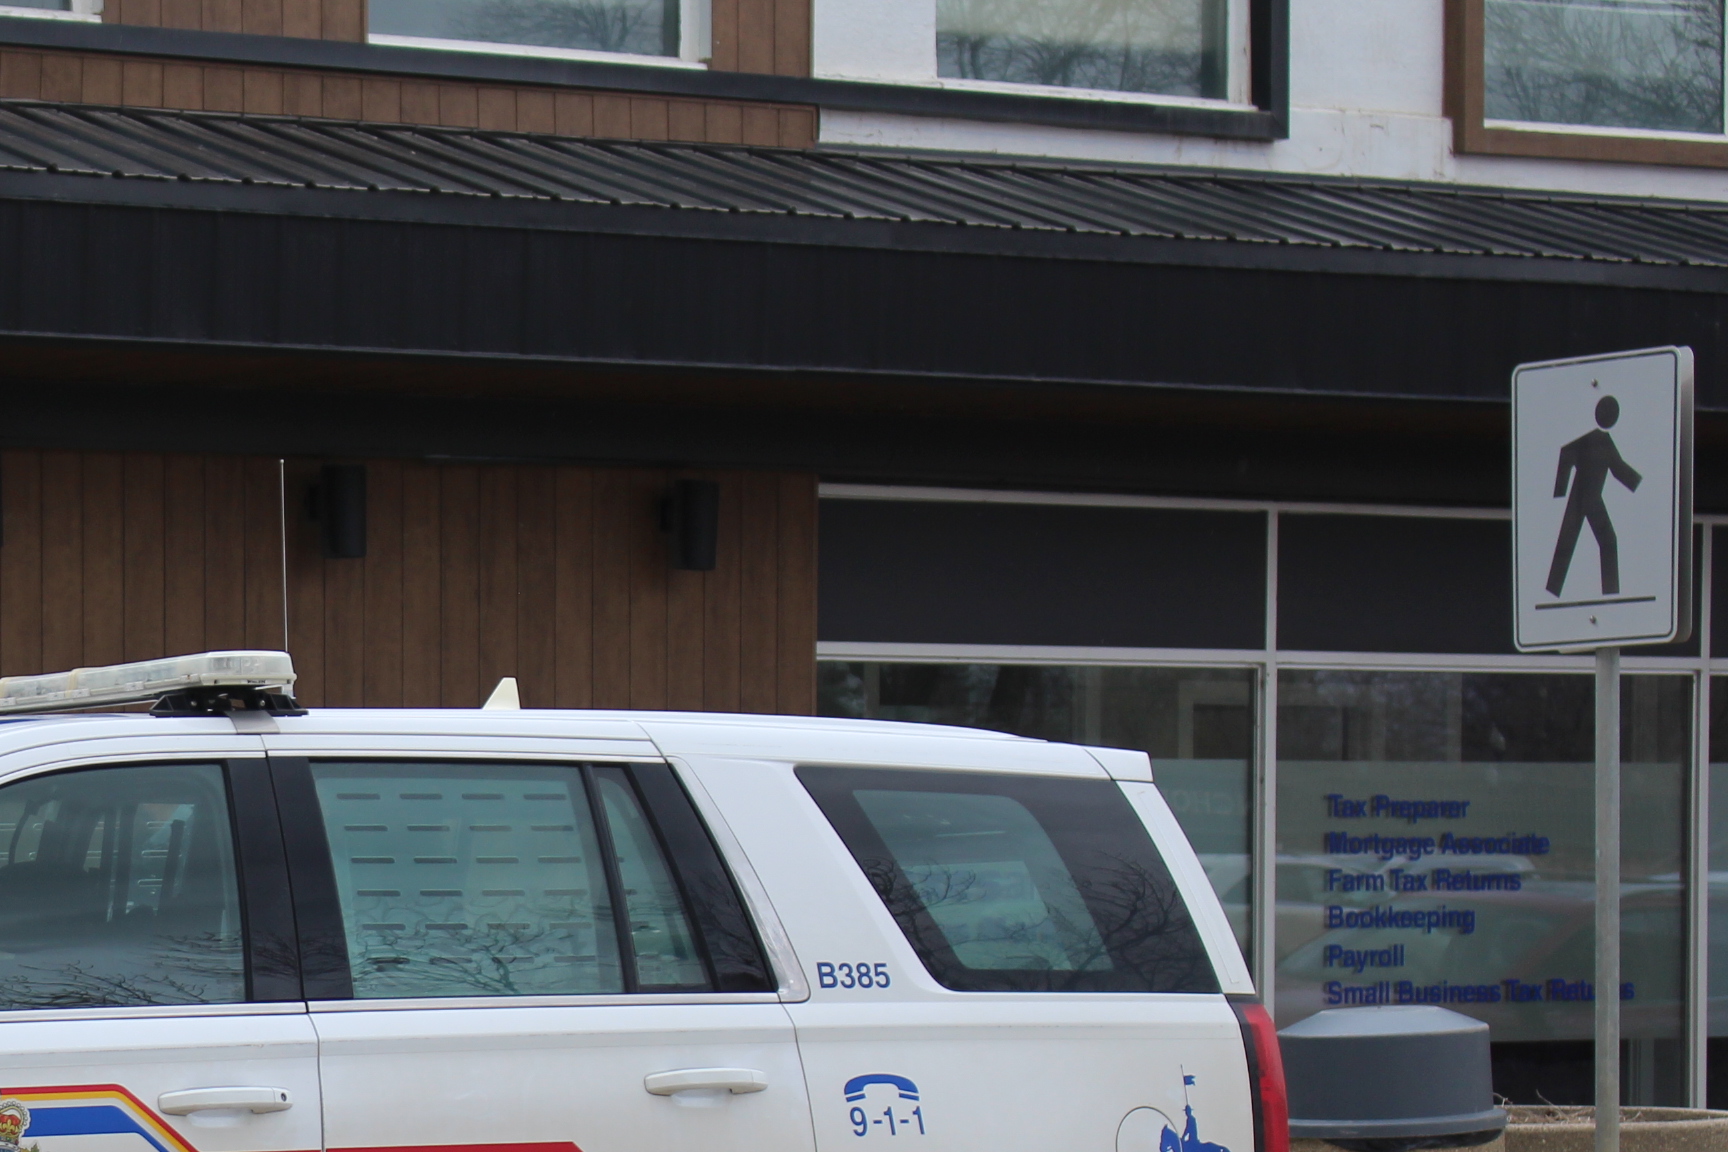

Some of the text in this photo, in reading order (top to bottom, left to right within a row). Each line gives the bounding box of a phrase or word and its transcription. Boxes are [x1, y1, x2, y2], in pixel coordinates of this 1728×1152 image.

[1325, 793, 1470, 824] Tax Preparer
[1325, 832, 1551, 861] Mortgage Associate
[1325, 869, 1522, 892] Farm Tax Returns
[1325, 904, 1476, 934] Bookkeeping
[1325, 944, 1405, 973] Payroll
[816, 961, 891, 989] B385
[1325, 978, 1635, 1005] Small Business Tax Retus
[849, 1105, 925, 1137] 9-1-1
